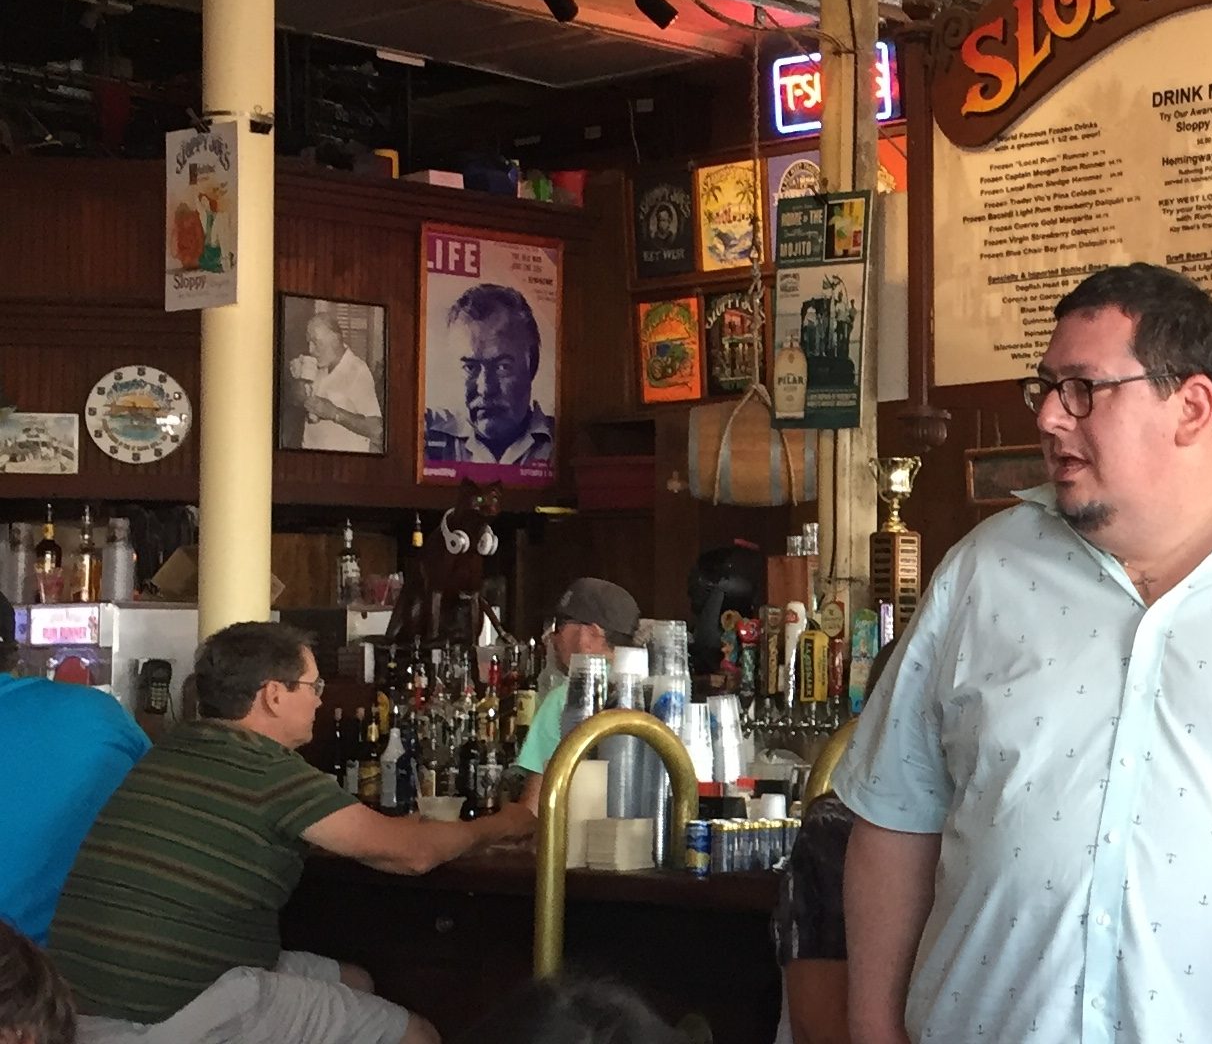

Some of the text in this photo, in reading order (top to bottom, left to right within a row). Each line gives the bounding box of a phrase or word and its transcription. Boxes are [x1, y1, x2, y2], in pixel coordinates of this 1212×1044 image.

[1152, 85, 1203, 107] DRINK
[1160, 112, 1171, 122] Try
[1174, 109, 1188, 119] Our
[1176, 118, 1210, 132] Sloppy
[427, 238, 478, 274] IFE
[780, 241, 812, 257] MOJITO
[173, 274, 207, 291] Sloppy
[777, 376, 805, 385] PILAR
